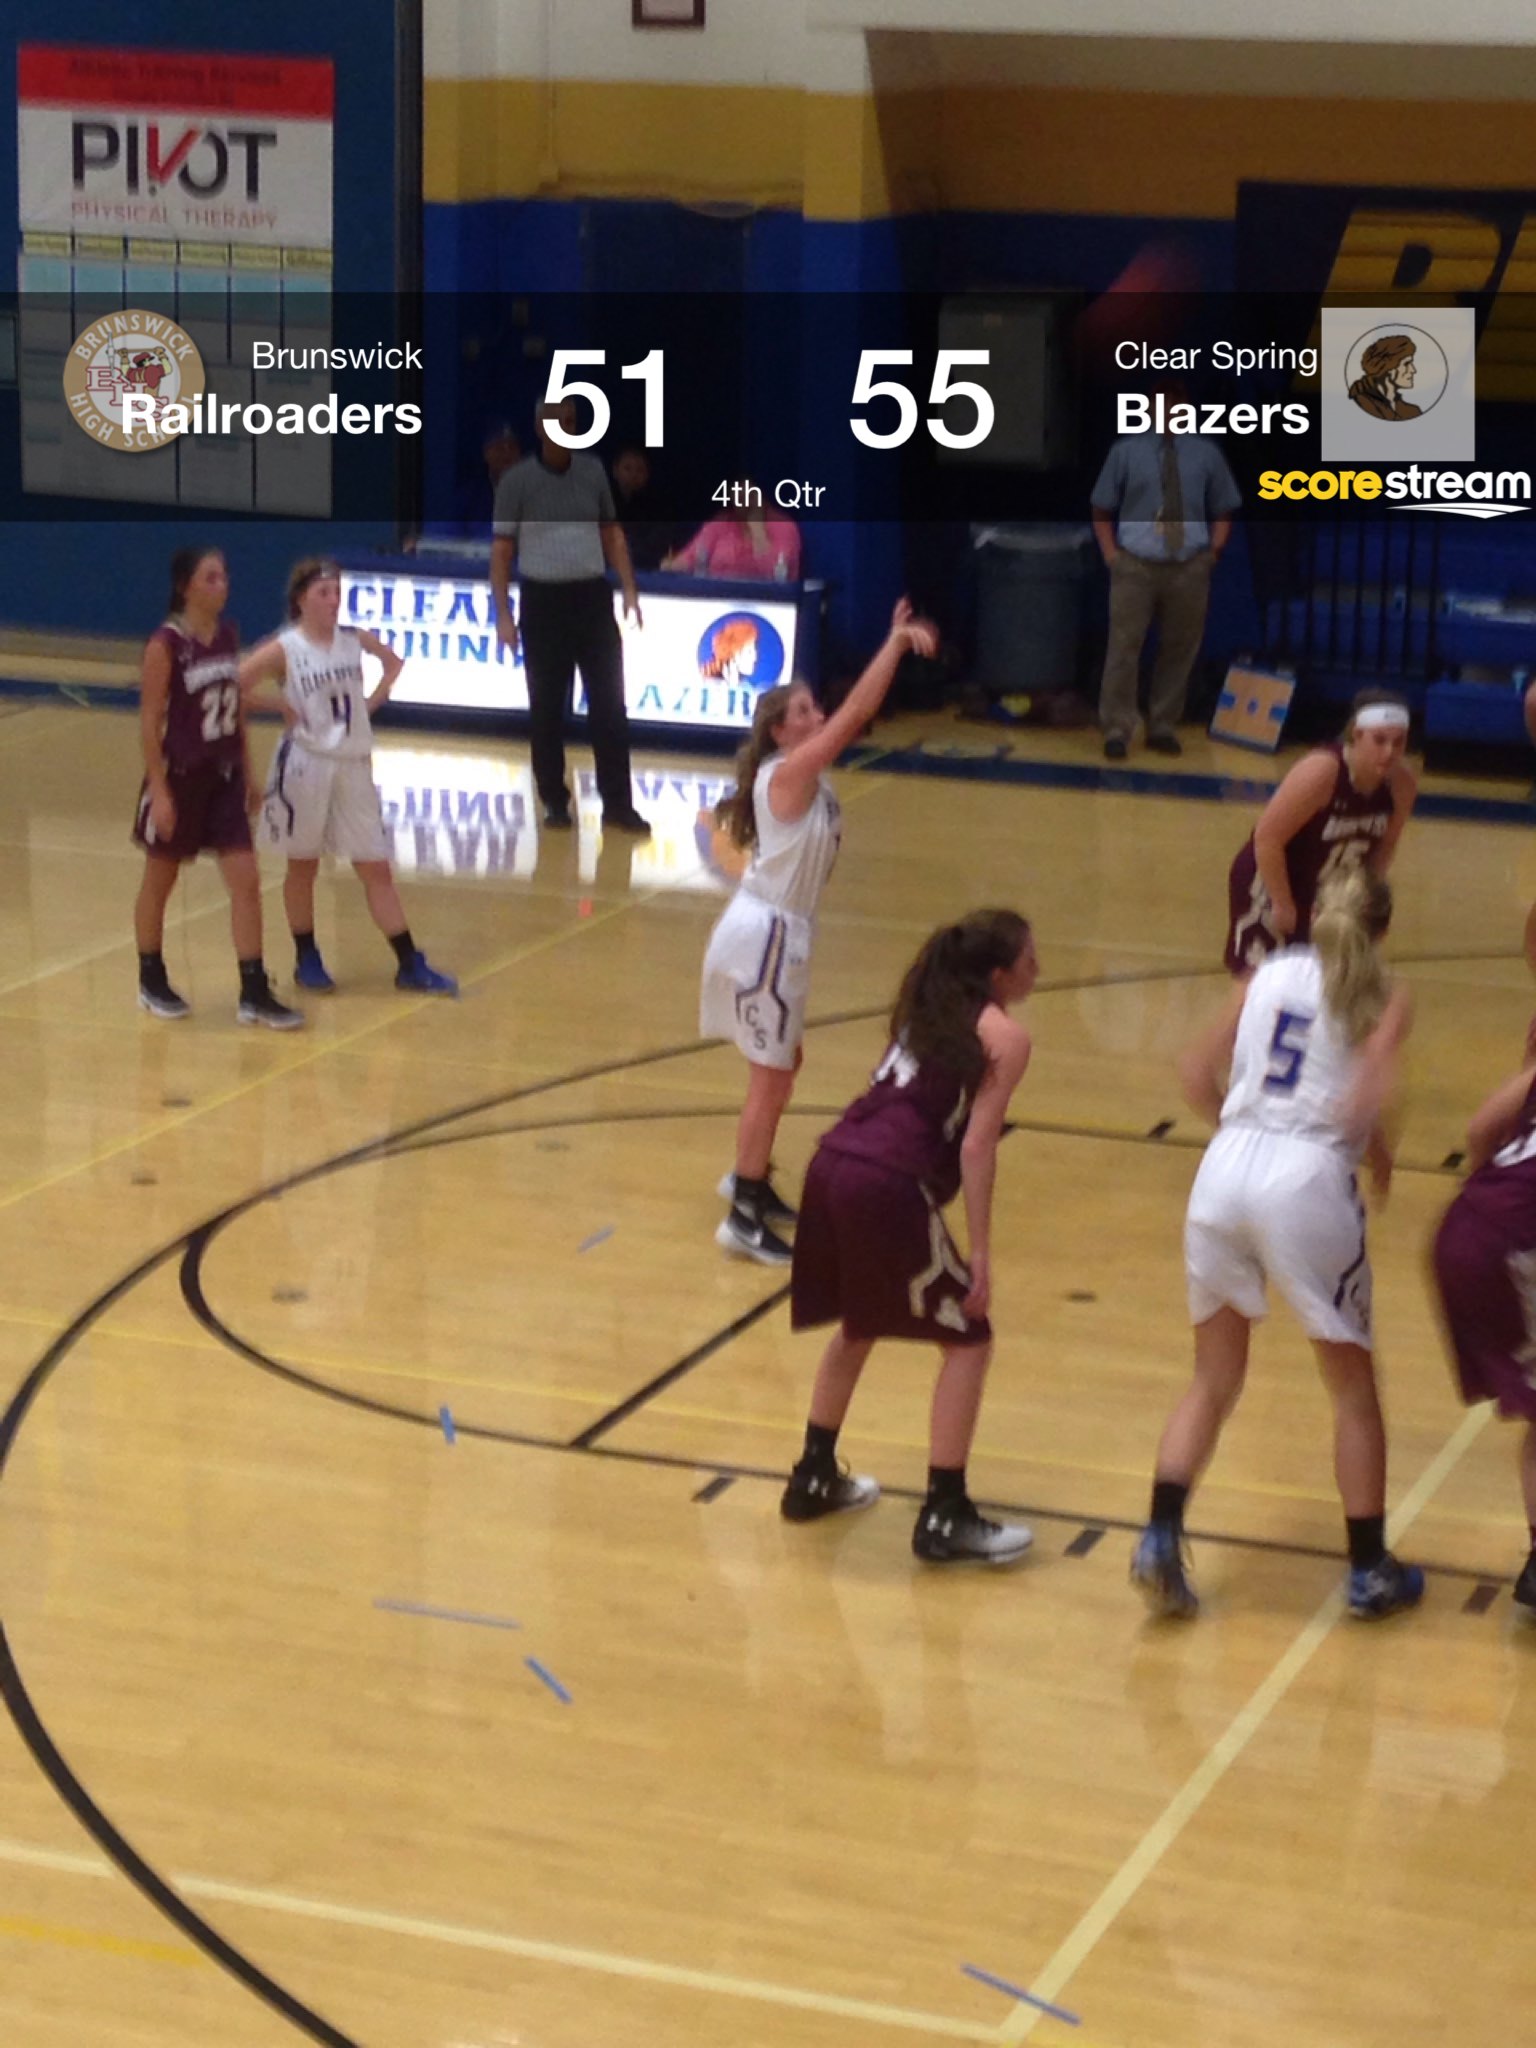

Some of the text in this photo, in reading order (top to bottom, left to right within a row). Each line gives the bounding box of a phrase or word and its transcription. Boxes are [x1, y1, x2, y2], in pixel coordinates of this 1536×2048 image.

[72, 121, 277, 202] PIVOT
[72, 202, 278, 231] PHYSICAL THERAPY
[195, 685, 239, 742] 22
[1262, 1008, 1312, 1094] 5
